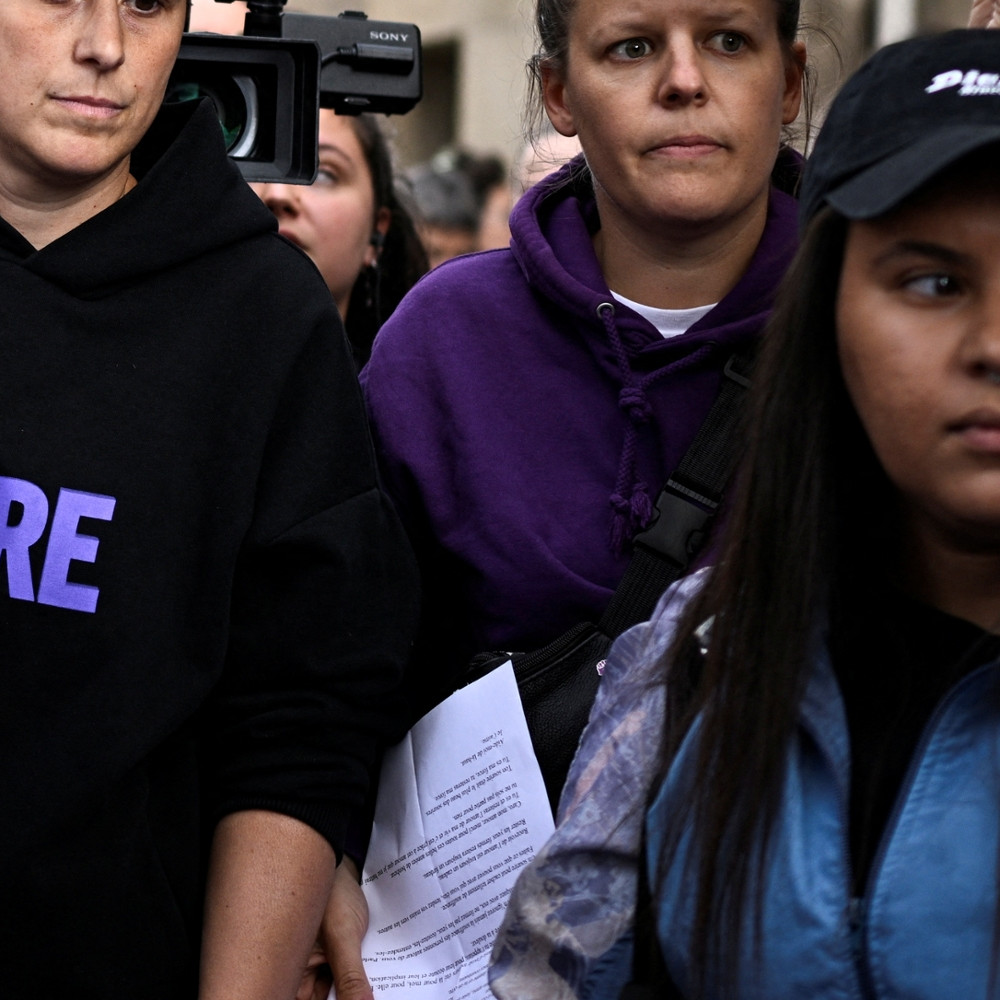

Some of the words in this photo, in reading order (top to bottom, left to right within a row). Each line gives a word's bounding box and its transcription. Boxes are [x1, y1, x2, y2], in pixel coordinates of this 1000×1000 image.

[370, 31, 408, 42] SONY
[487, 771, 501, 781] sourire
[461, 786, 471, 795] plus
[497, 808, 507, 816] mon
[512, 819, 526, 829] Rester
[459, 828, 468, 838] pour
[493, 829, 503, 839] yeux
[508, 828, 528, 841] Recevoir
[484, 842, 501, 855] l'amour
[519, 846, 533, 855] Faites
[460, 856, 476, 868] toujours
[504, 856, 512, 864] que
[512, 860, 527, 870] sourire
[478, 866, 492, 879] pouvez
[501, 866, 511, 876] peut
[467, 877, 476, 885] avec
[474, 911, 487, 923] jamais
[423, 937, 443, 952] personnes
[406, 950, 422, 958] autour
[455, 957, 464, 966] pour
